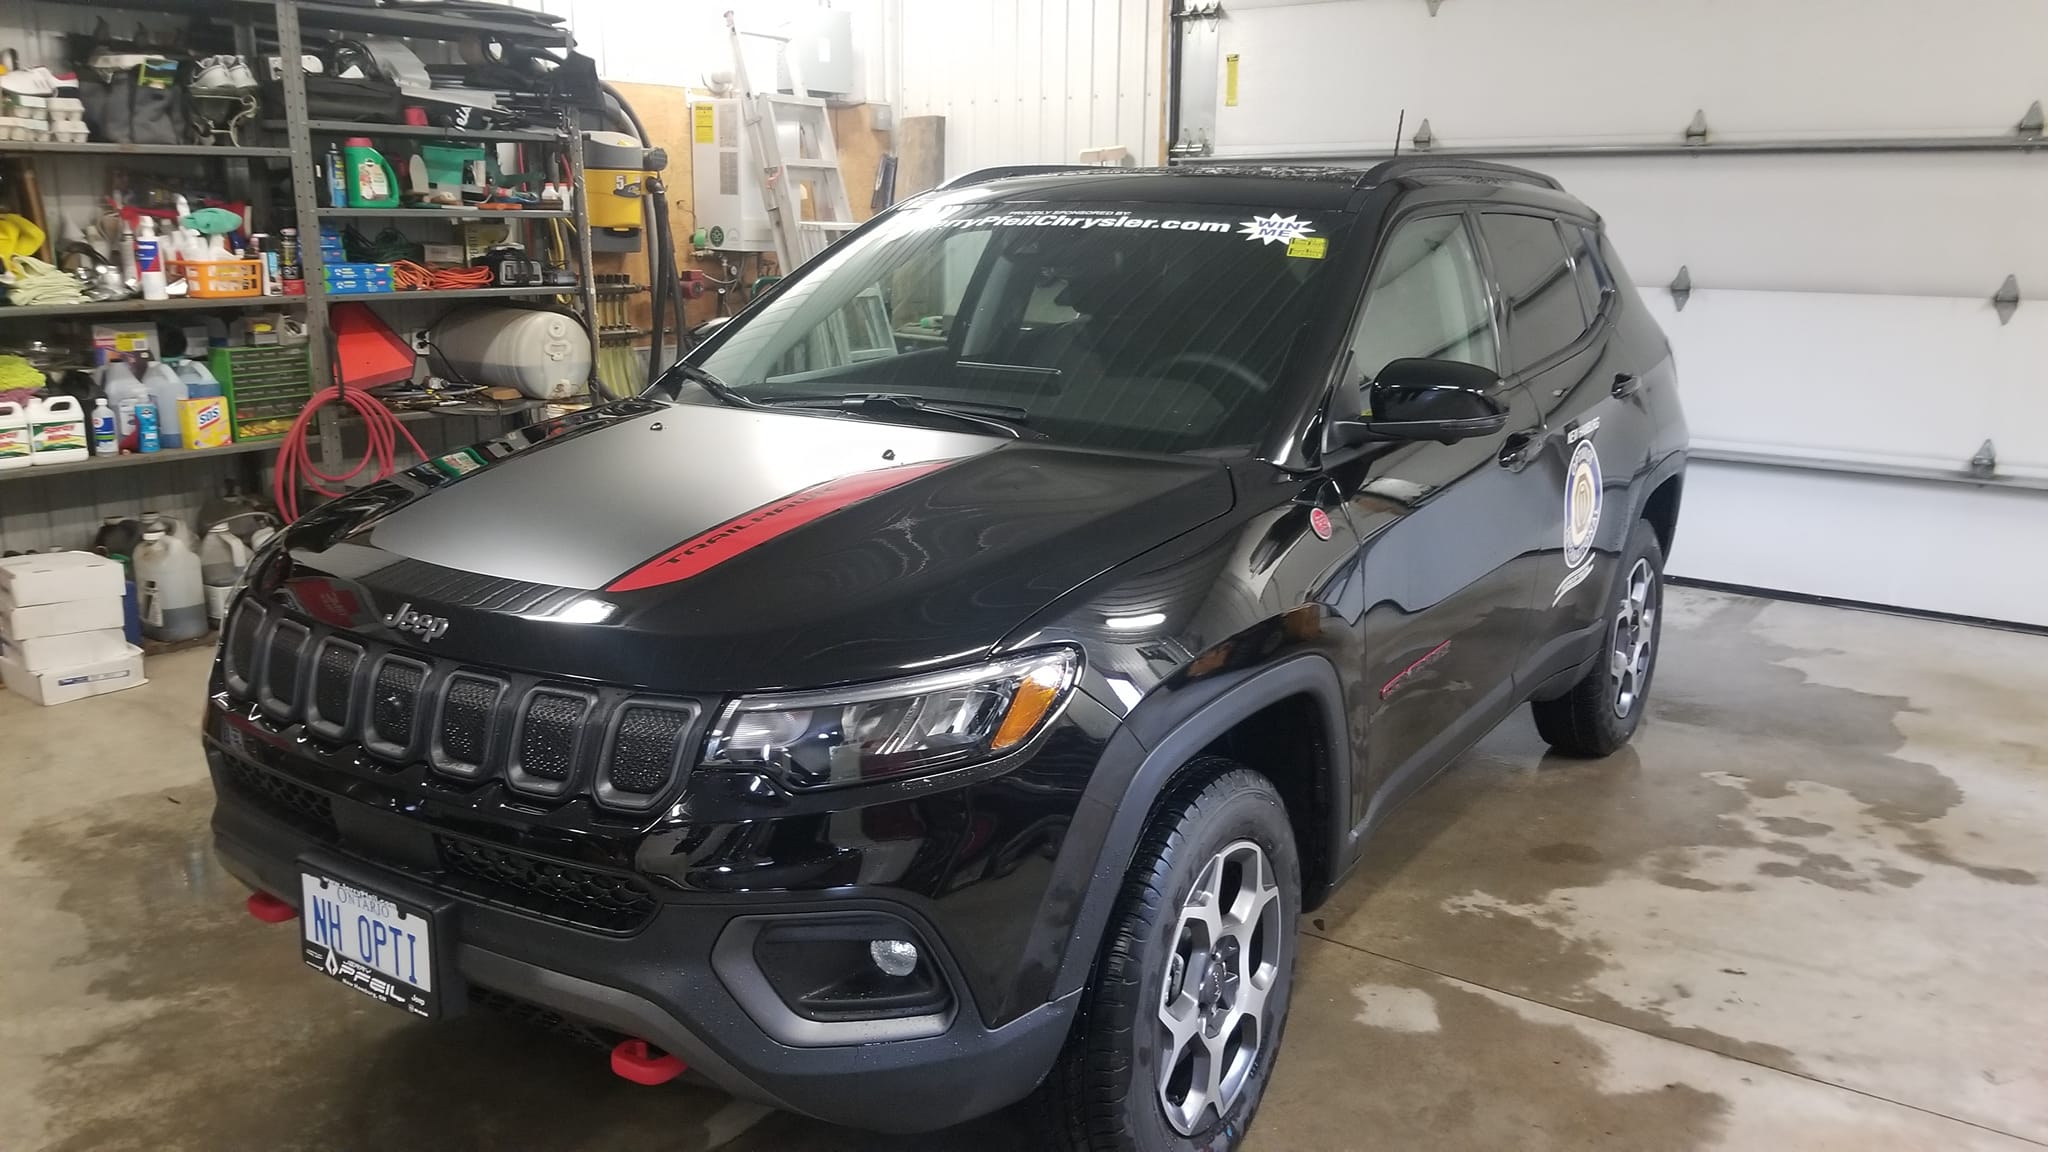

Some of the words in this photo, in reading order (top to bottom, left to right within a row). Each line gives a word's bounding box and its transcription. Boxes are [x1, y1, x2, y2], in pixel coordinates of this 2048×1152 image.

[933, 214, 1231, 233] erryPfeilChrysler.com
[1258, 219, 1301, 231] WIN
[1258, 228, 1292, 238] ME
[384, 602, 449, 643] Jeep
[337, 886, 390, 918] ONTARIO
[312, 894, 343, 952] NH
[358, 914, 417, 984] OPTI
[342, 960, 372, 974] JERRY
[338, 964, 406, 1003] PFEIL
